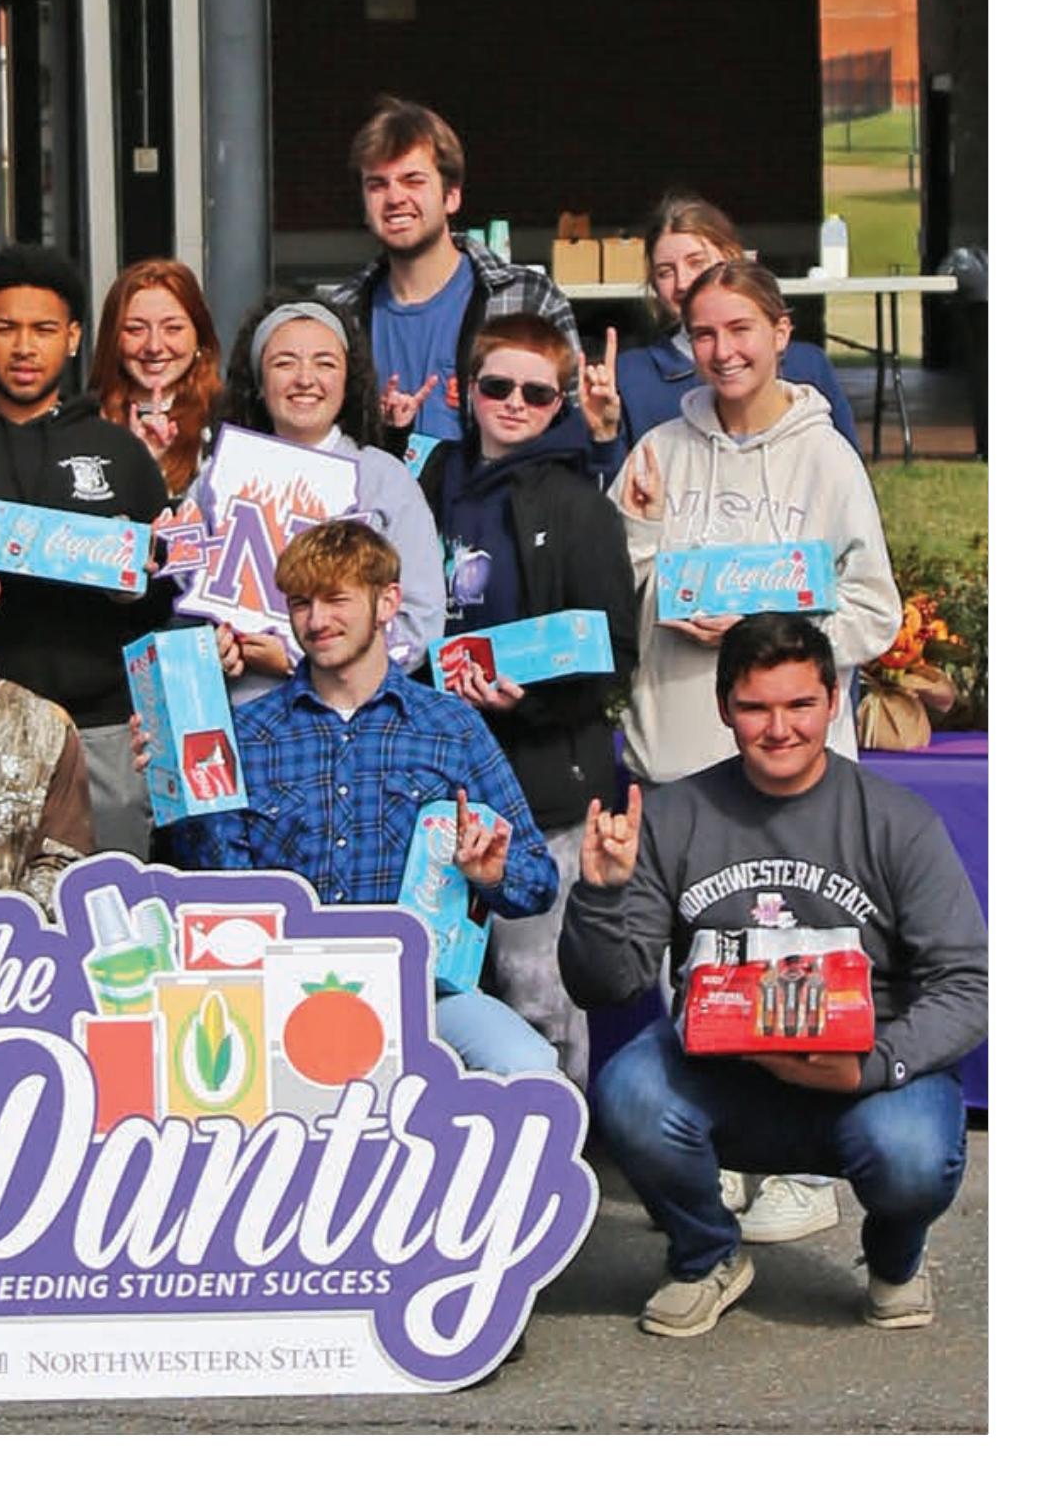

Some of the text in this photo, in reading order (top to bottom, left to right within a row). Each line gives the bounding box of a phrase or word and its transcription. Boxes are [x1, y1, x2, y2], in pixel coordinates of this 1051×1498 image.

[678, 860, 878, 925] NORTHWESTERN STATE
[117, 1272, 255, 1298] STUDENT
[263, 1269, 392, 1297] SUCCESS
[28, 1346, 355, 1374] NORTHWESTERN STATE
